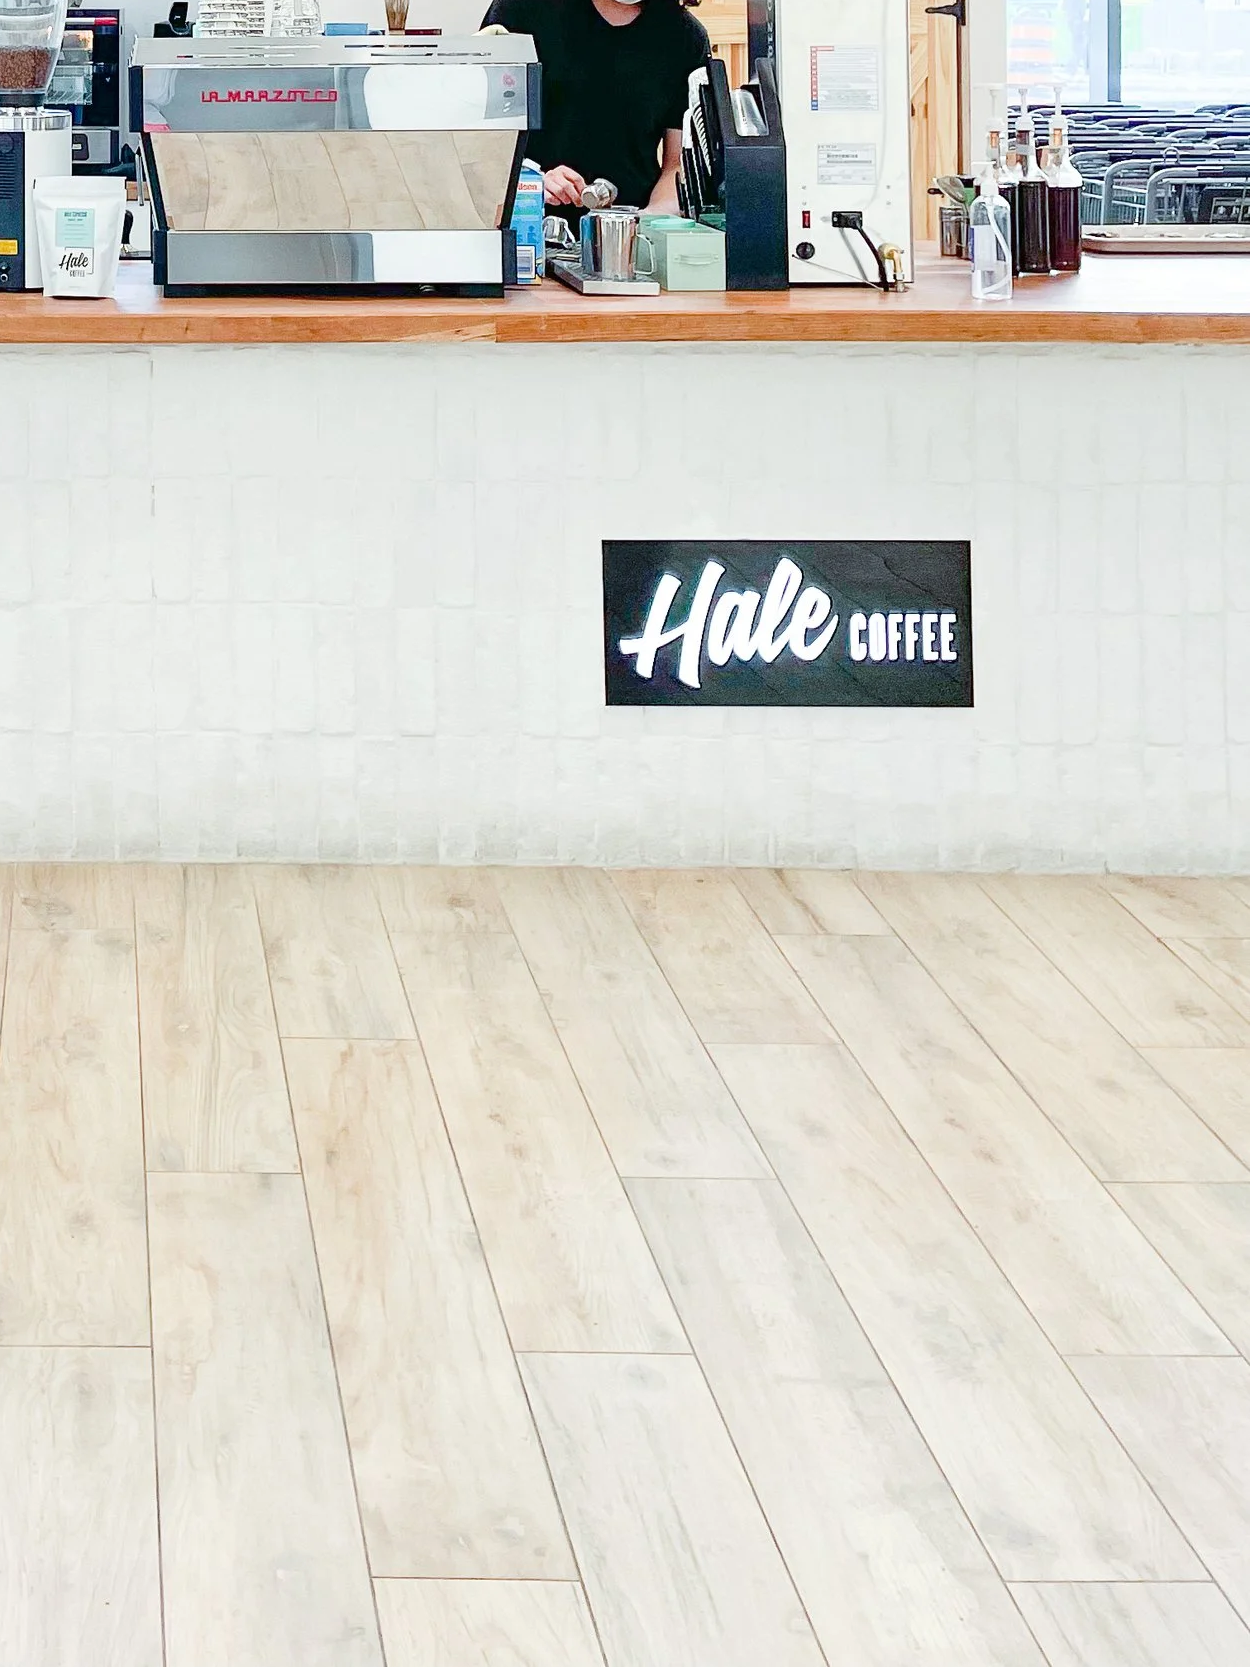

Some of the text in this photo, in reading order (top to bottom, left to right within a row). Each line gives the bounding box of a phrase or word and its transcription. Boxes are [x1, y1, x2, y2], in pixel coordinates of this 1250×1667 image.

[58, 253, 89, 271] Hale
[619, 556, 958, 689] Hale COFFEE
